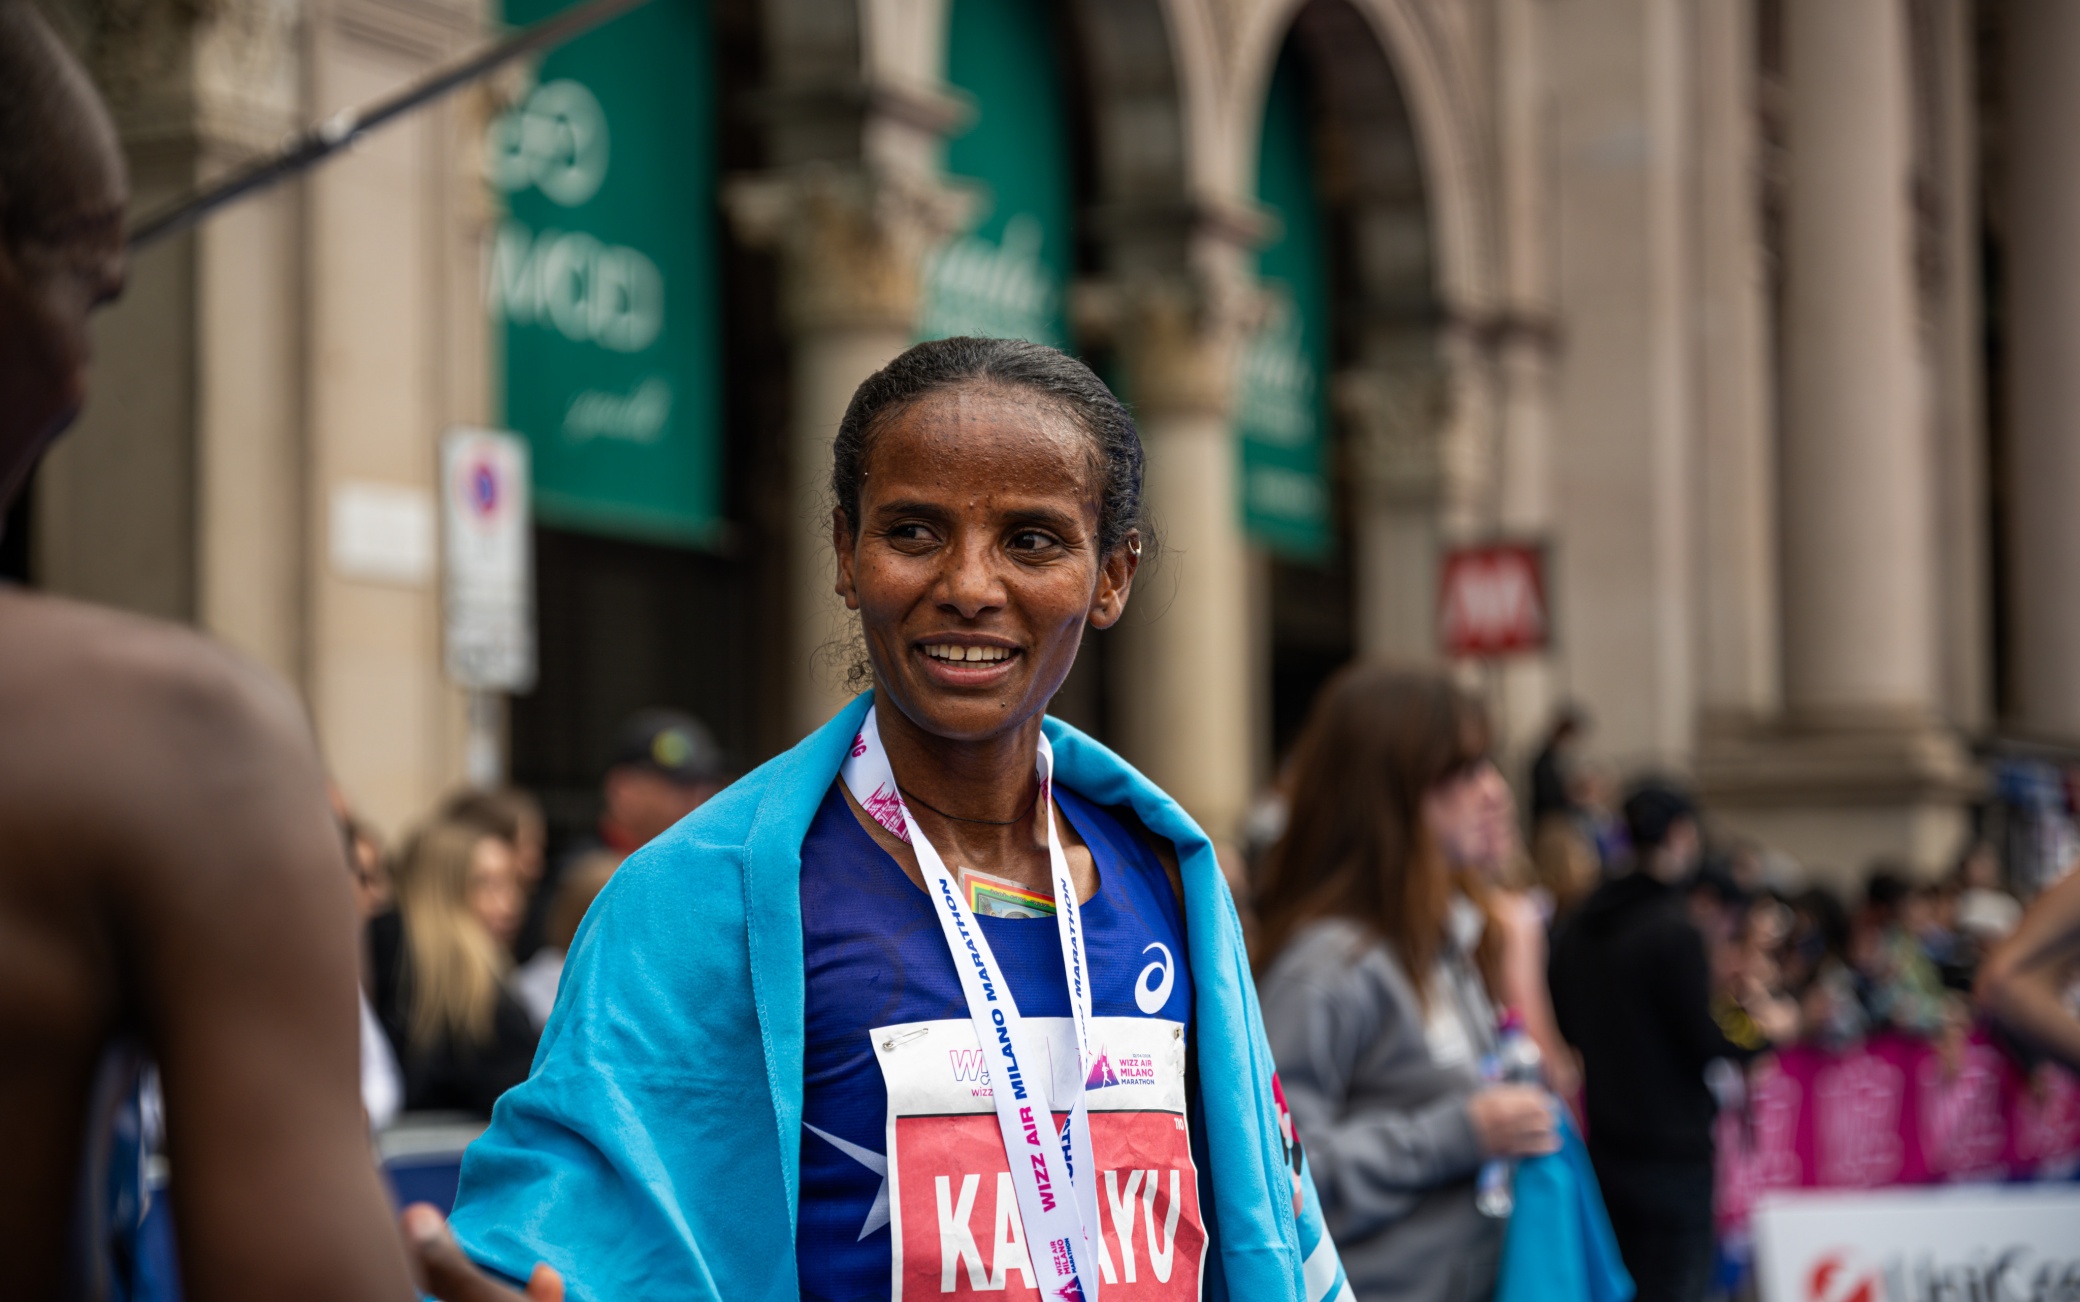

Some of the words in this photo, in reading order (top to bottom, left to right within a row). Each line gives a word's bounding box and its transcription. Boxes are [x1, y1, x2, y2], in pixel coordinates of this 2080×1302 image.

[939, 879, 998, 1002] MARATHON
[1060, 878, 1082, 999] MARATHON
[991, 1008, 1028, 1100] MILANO
[1119, 1059, 1138, 1067] WIZZ
[1140, 1059, 1153, 1067] AIR
[1120, 1068, 1154, 1077] MILANO
[1019, 1106, 1041, 1146] AIR
[1031, 1153, 1057, 1213] WIZZ
[934, 1169, 1180, 1293] KAYU
[1050, 1240, 1058, 1254] AIR
[1053, 1255, 1063, 1276] WIZZ
[1057, 1238, 1071, 1275] MILANO
[1064, 1237, 1077, 1274] MARATHON
